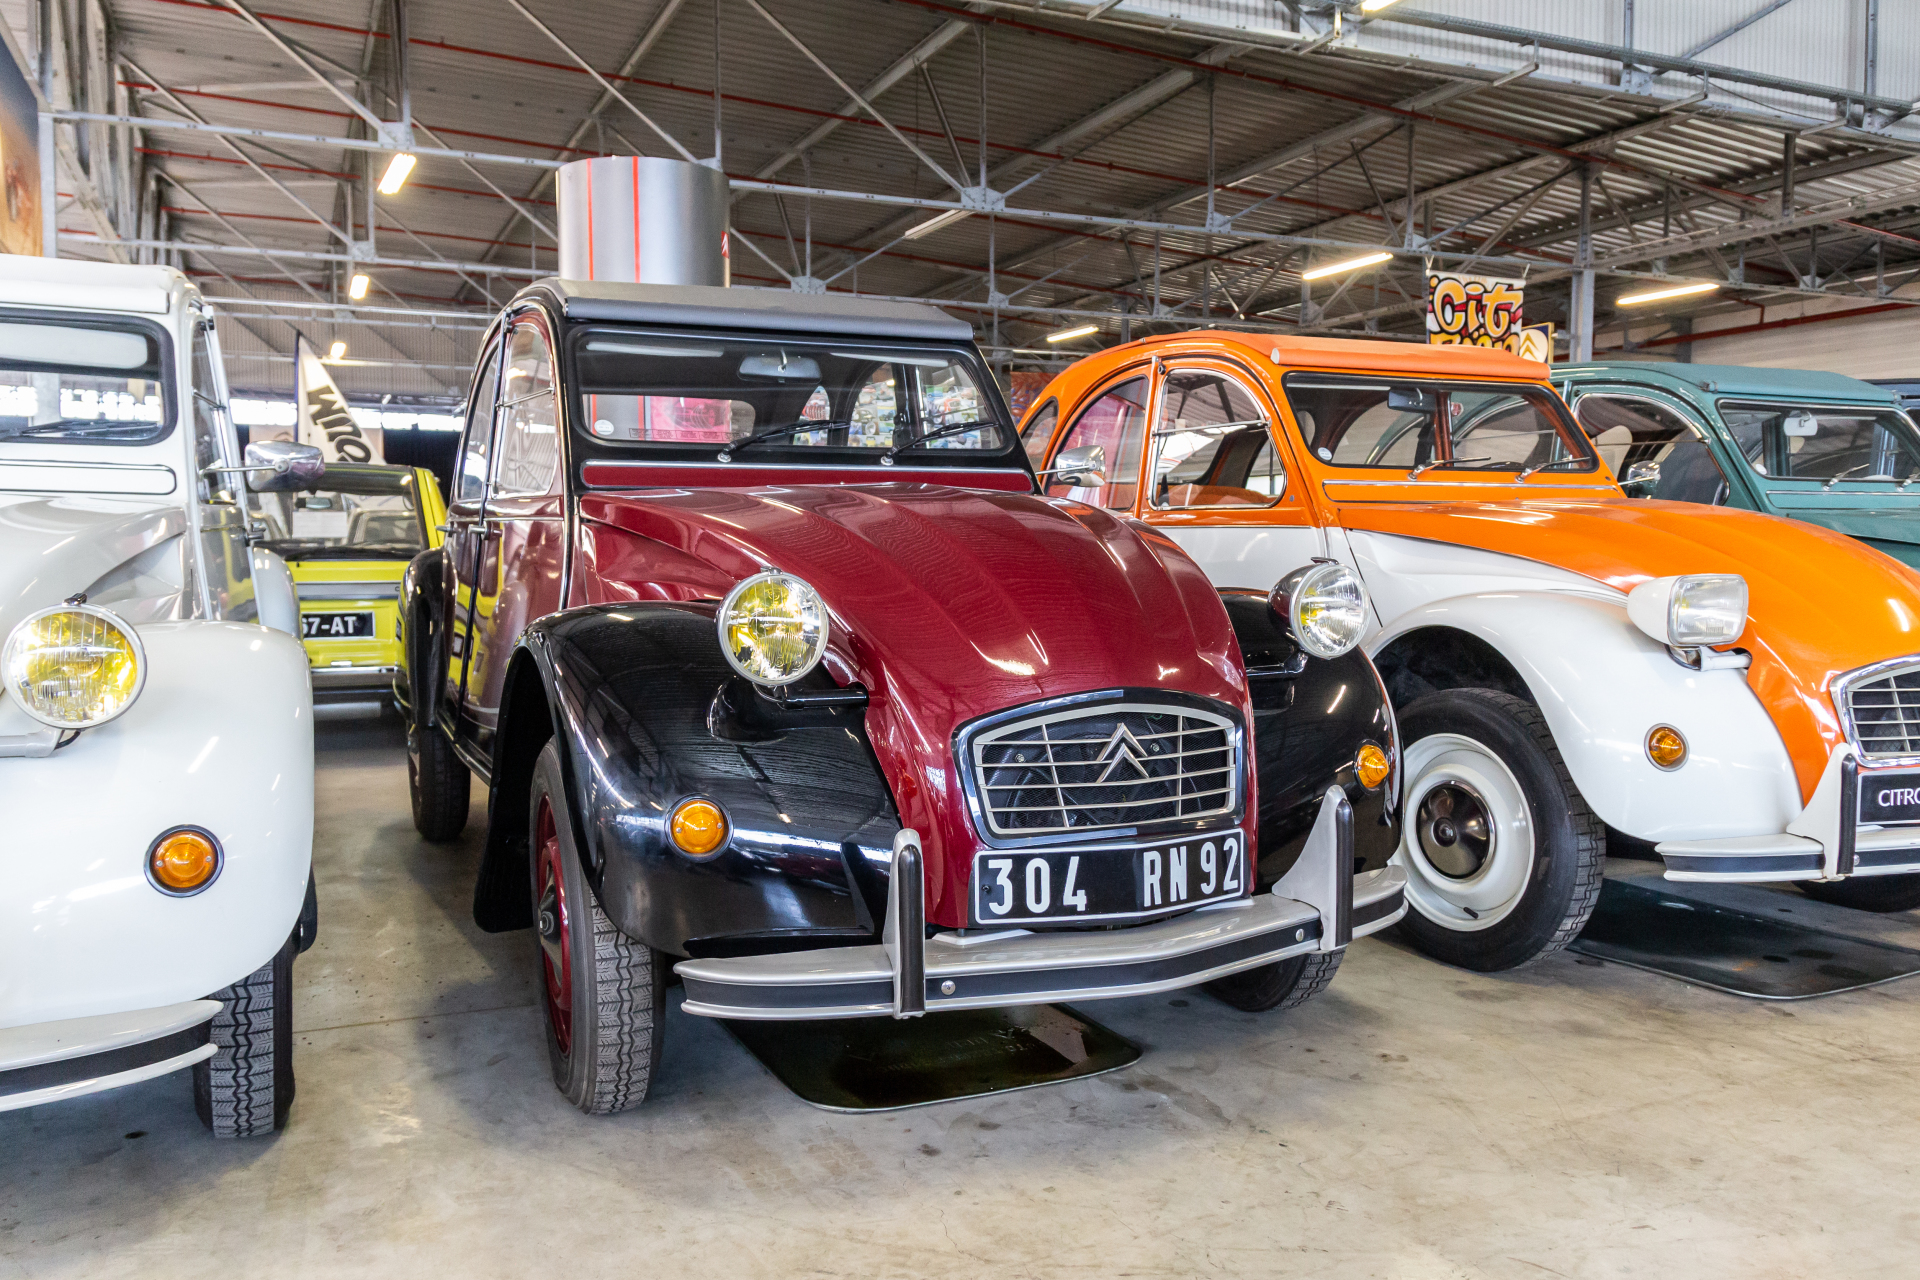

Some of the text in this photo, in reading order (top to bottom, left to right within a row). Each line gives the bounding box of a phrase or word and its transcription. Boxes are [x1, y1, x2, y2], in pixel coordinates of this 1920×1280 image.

[1433, 277, 1524, 339] Cit
[307, 384, 372, 463] OUM
[987, 855, 1088, 916] 304
